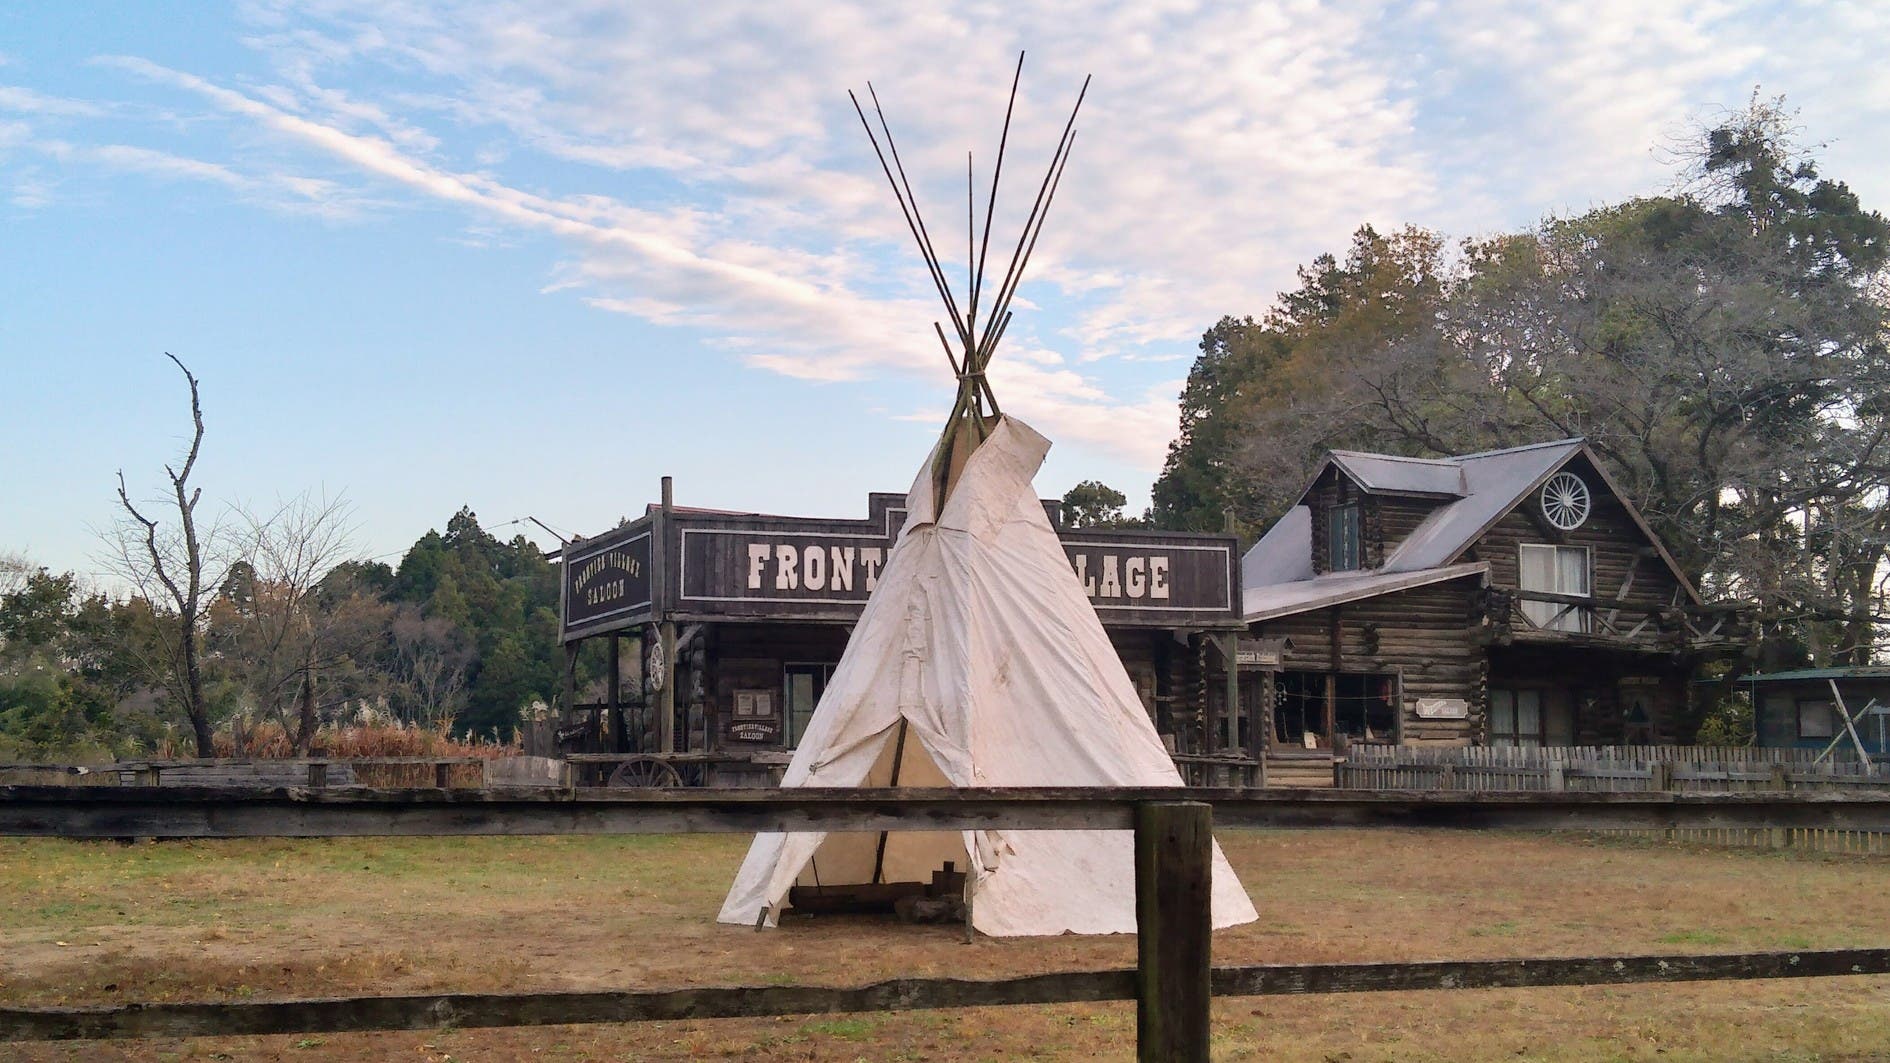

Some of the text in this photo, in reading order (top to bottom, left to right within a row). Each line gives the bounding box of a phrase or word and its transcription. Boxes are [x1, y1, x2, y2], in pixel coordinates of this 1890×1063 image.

[748, 544, 893, 592] FRONT
[587, 578, 624, 606] SALOON
[740, 732, 764, 740] SALOON
